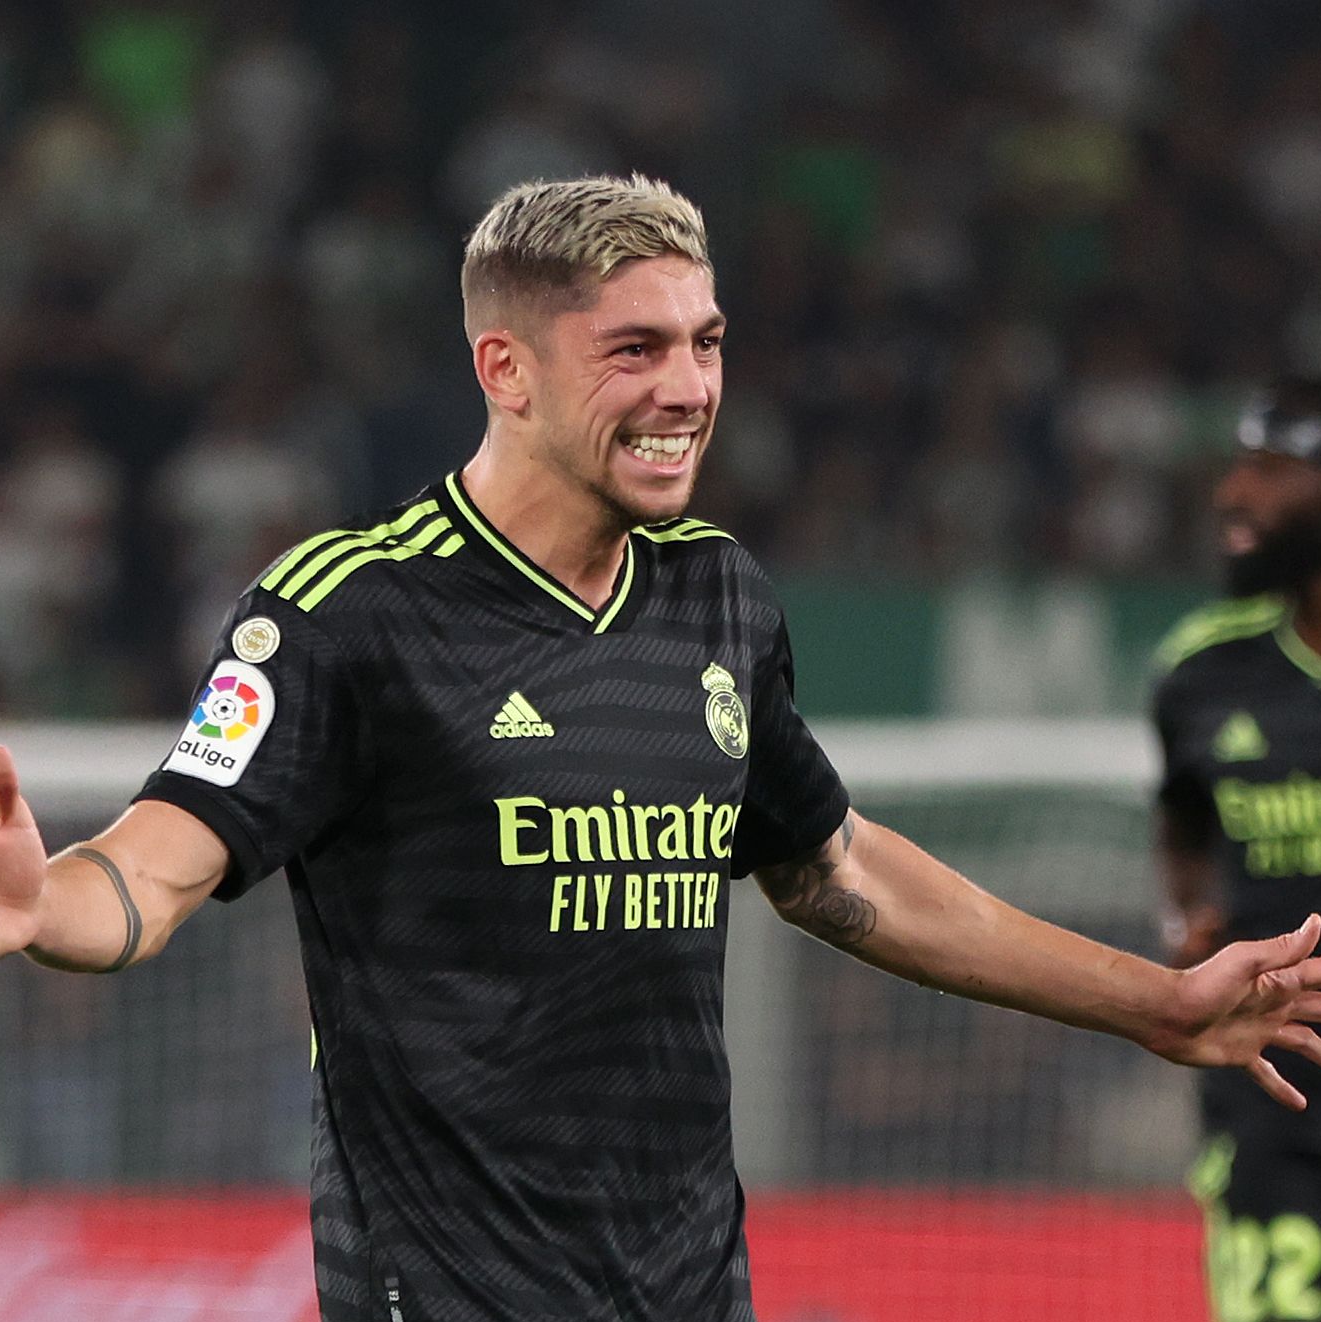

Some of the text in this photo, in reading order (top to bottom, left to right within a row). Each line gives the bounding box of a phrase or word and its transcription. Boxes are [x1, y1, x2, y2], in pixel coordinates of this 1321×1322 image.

[489, 720, 555, 739] adidas
[178, 740, 236, 770] aLiga
[493, 789, 742, 866] Emirate
[549, 873, 719, 932] FLY BETTER
